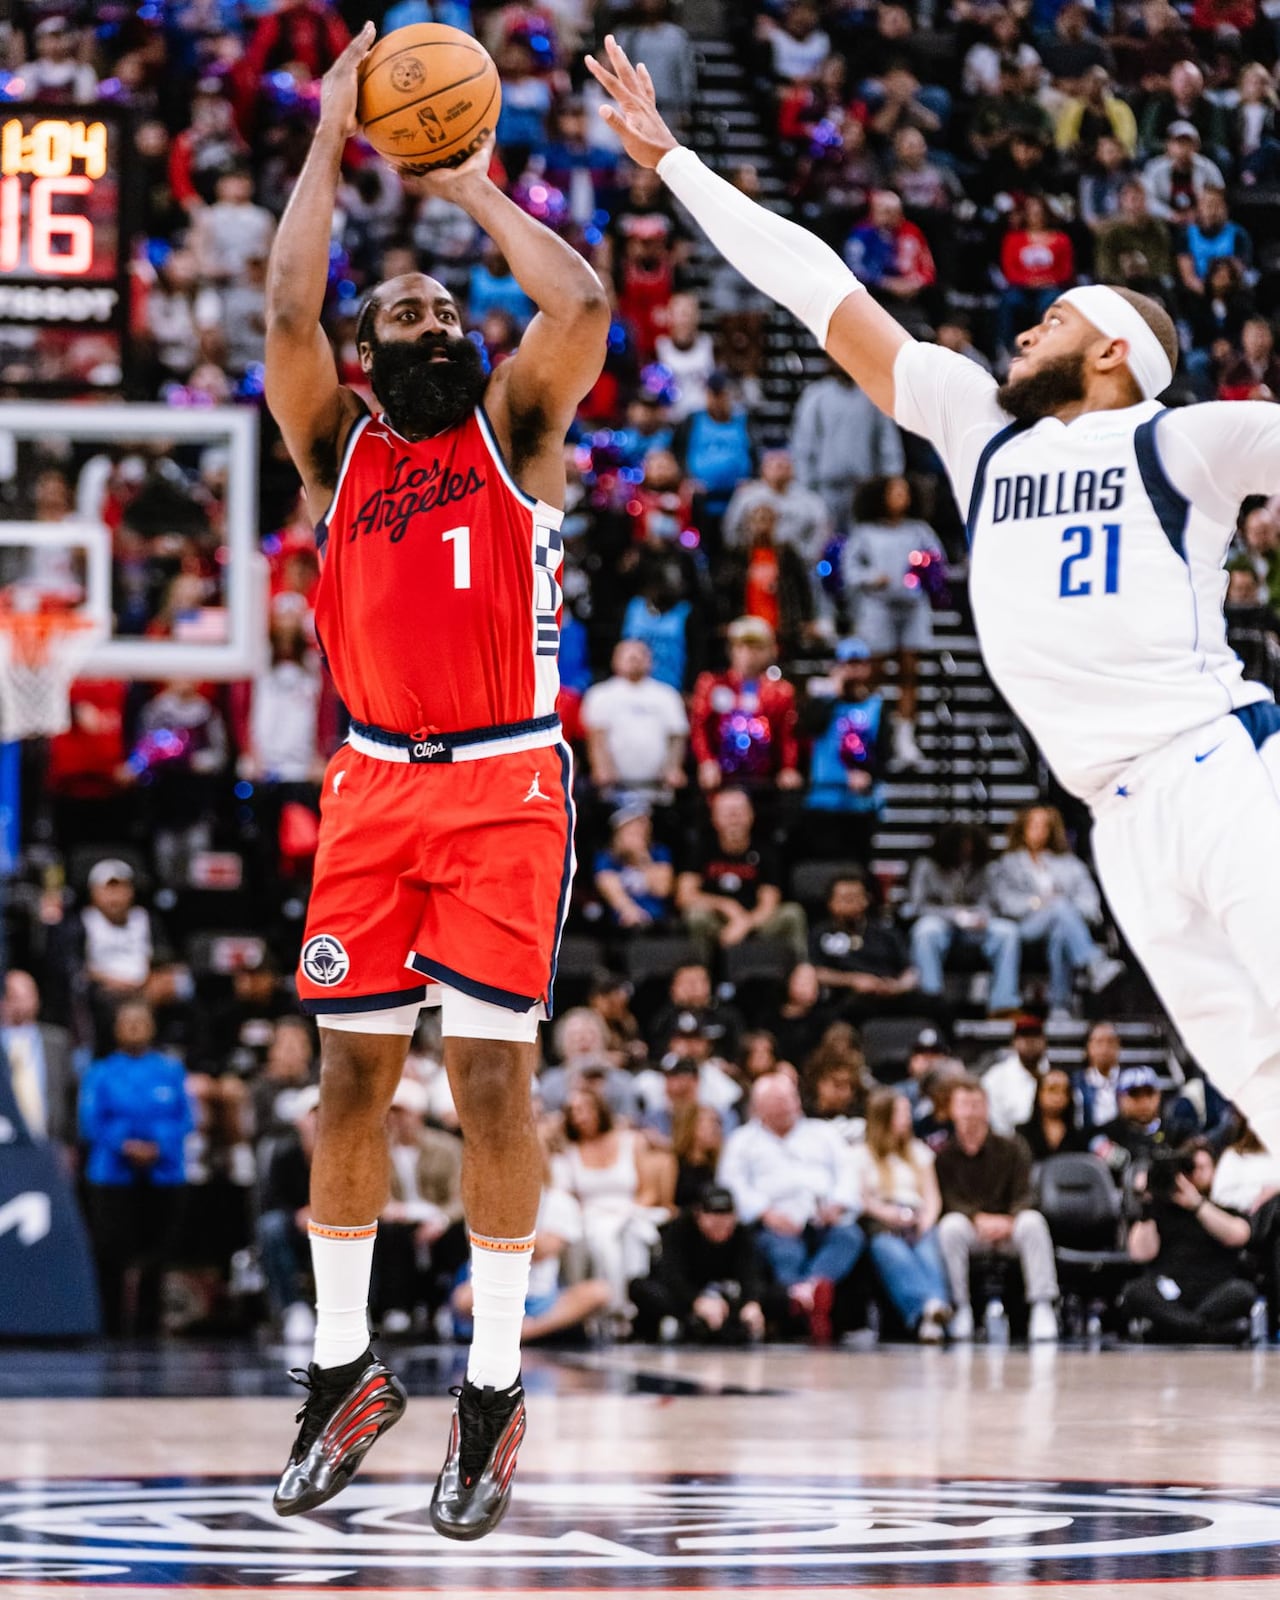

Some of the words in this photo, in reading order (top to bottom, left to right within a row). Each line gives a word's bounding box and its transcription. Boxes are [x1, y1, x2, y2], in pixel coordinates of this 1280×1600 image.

[1, 118, 108, 180] 1:04
[0, 174, 95, 275] 16
[350, 466, 486, 543] Angeles
[385, 456, 443, 495] Los
[992, 467, 1127, 525] DALLAS
[442, 526, 471, 590] 1
[1059, 523, 1121, 598] 21
[413, 741, 446, 759] Clips
